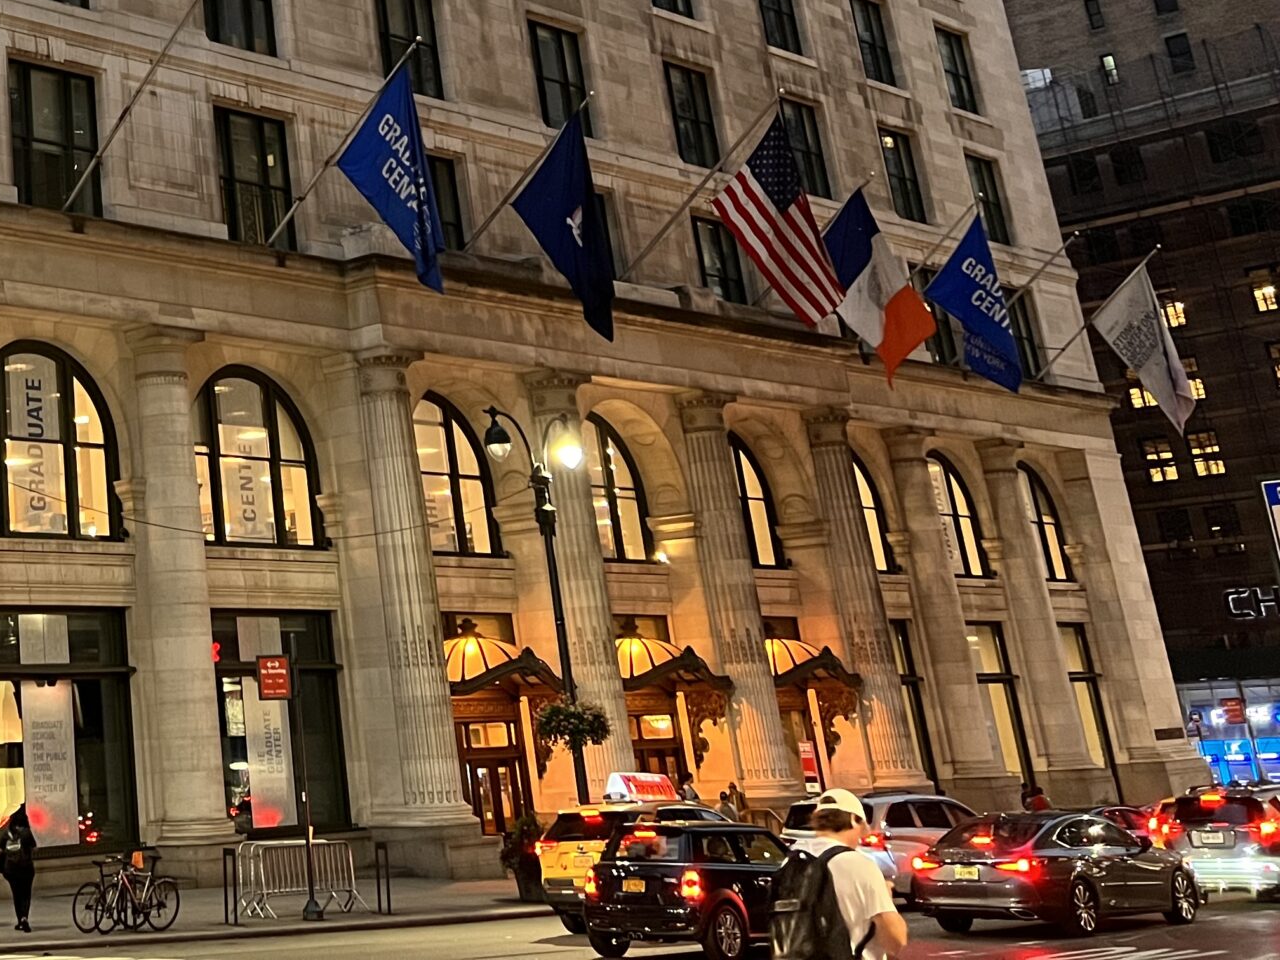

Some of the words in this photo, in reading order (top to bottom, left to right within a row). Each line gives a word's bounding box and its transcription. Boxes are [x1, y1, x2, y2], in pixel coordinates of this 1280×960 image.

[961, 257, 1003, 297] GRAD
[971, 289, 1010, 328] CENT
[25, 378, 47, 512] GRADUATE
[237, 441, 257, 523] CENTE
[257, 751, 266, 775] THE
[263, 709, 275, 774] GRADUATE
[273, 727, 284, 774] CENTER
